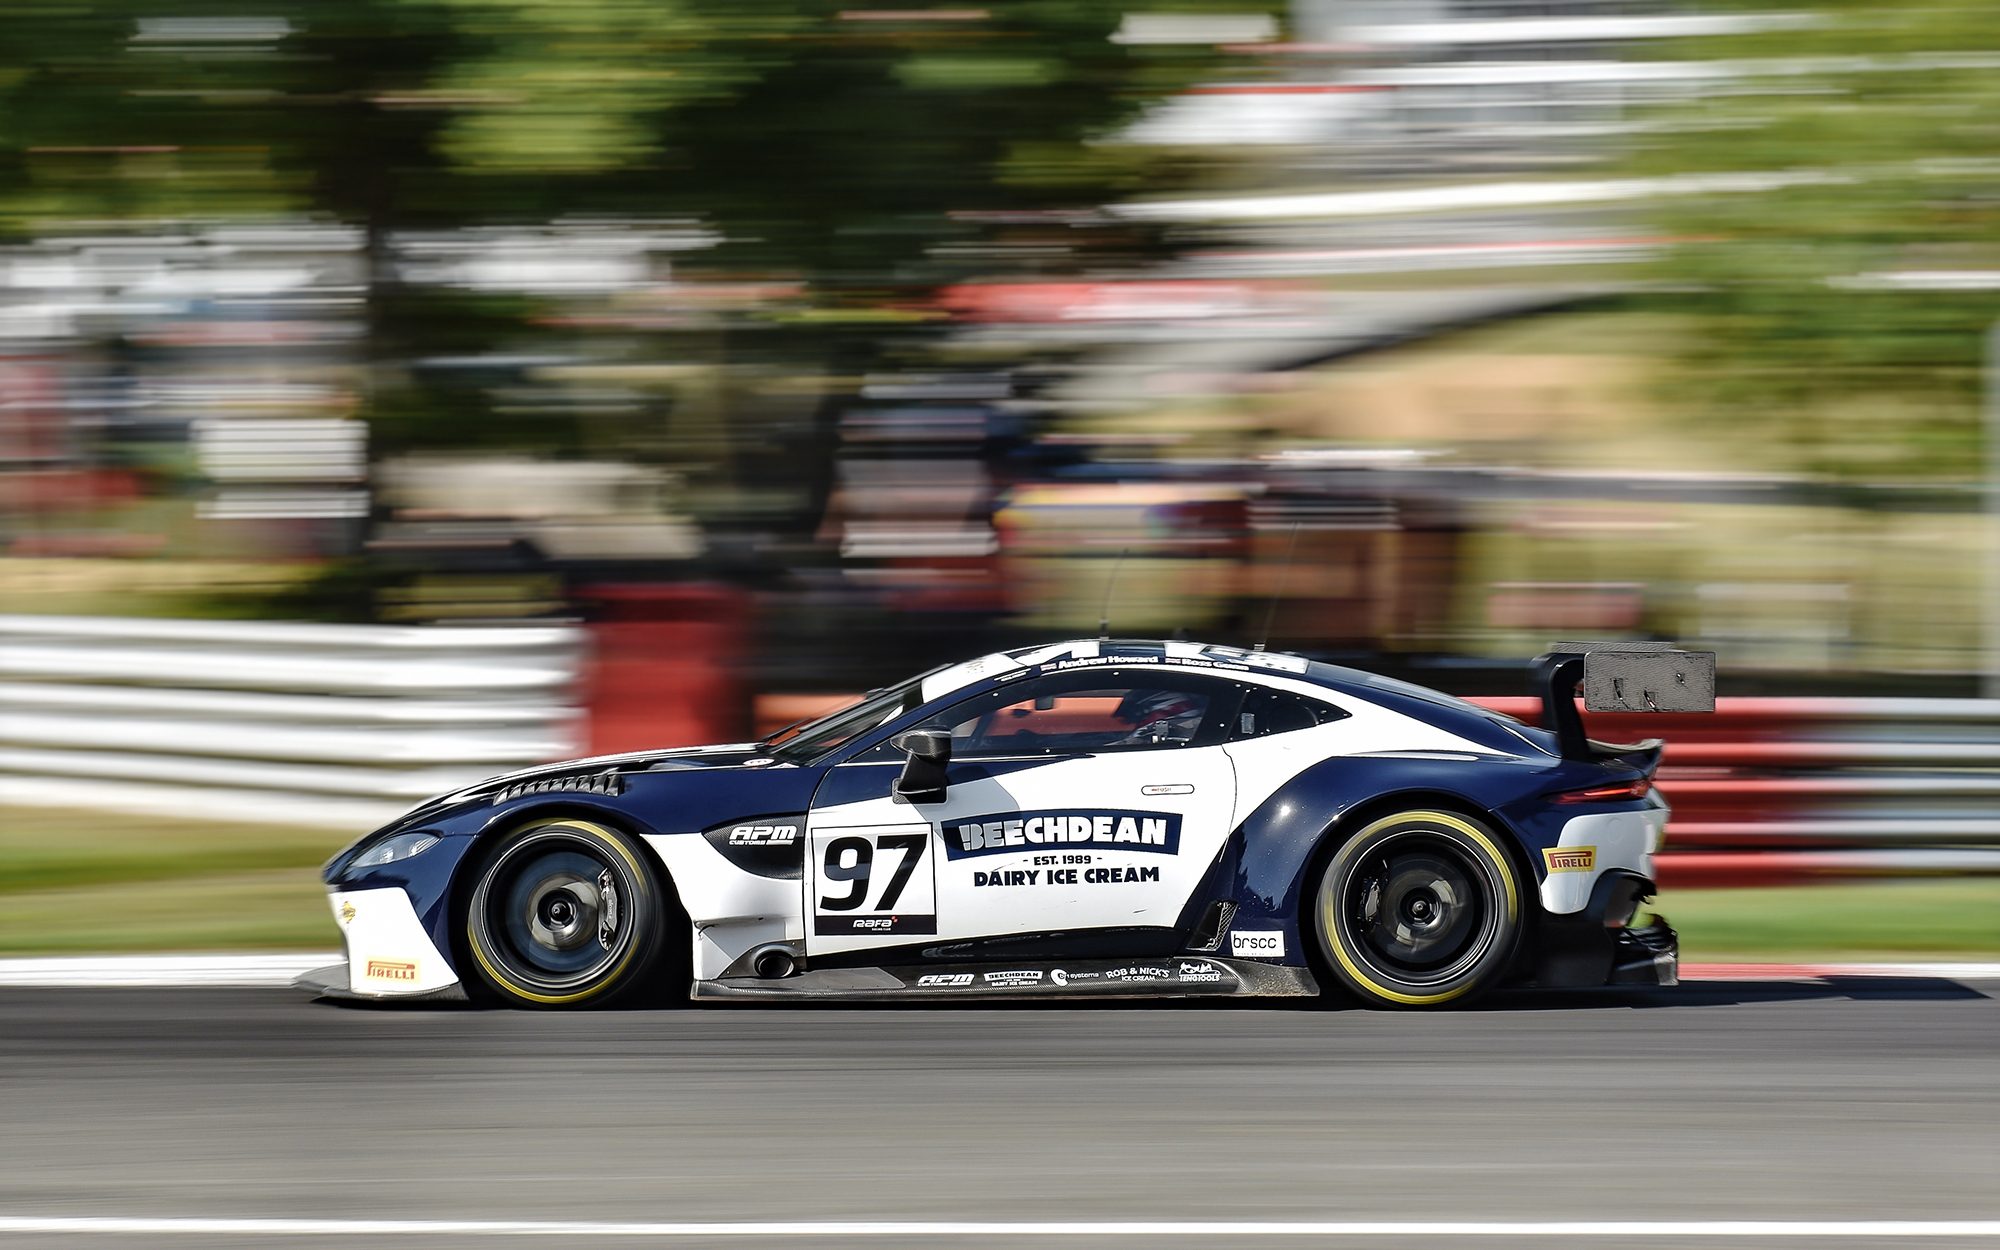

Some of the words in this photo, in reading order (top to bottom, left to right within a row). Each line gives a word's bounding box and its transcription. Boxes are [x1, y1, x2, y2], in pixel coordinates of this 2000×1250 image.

[1058, 656, 1108, 669] Andrew
[1107, 655, 1159, 664] Howard
[729, 825, 797, 840] APM
[958, 816, 1167, 851] BEECHDEAN
[1033, 855, 1059, 865] EST.
[1062, 855, 1092, 865] 1989
[1548, 850, 1593, 868] PIRELLI
[820, 834, 928, 911] 97
[973, 870, 1040, 887] DAIRY
[1049, 869, 1078, 885] ICE
[1084, 867, 1160, 884] CREAM
[1233, 934, 1277, 949] brscc
[367, 961, 416, 980] PIRELLI
[1105, 967, 1128, 979] ROB
[1129, 967, 1138, 975] &
[1139, 967, 1170, 979] NICK'S
[918, 973, 975, 984] APM
